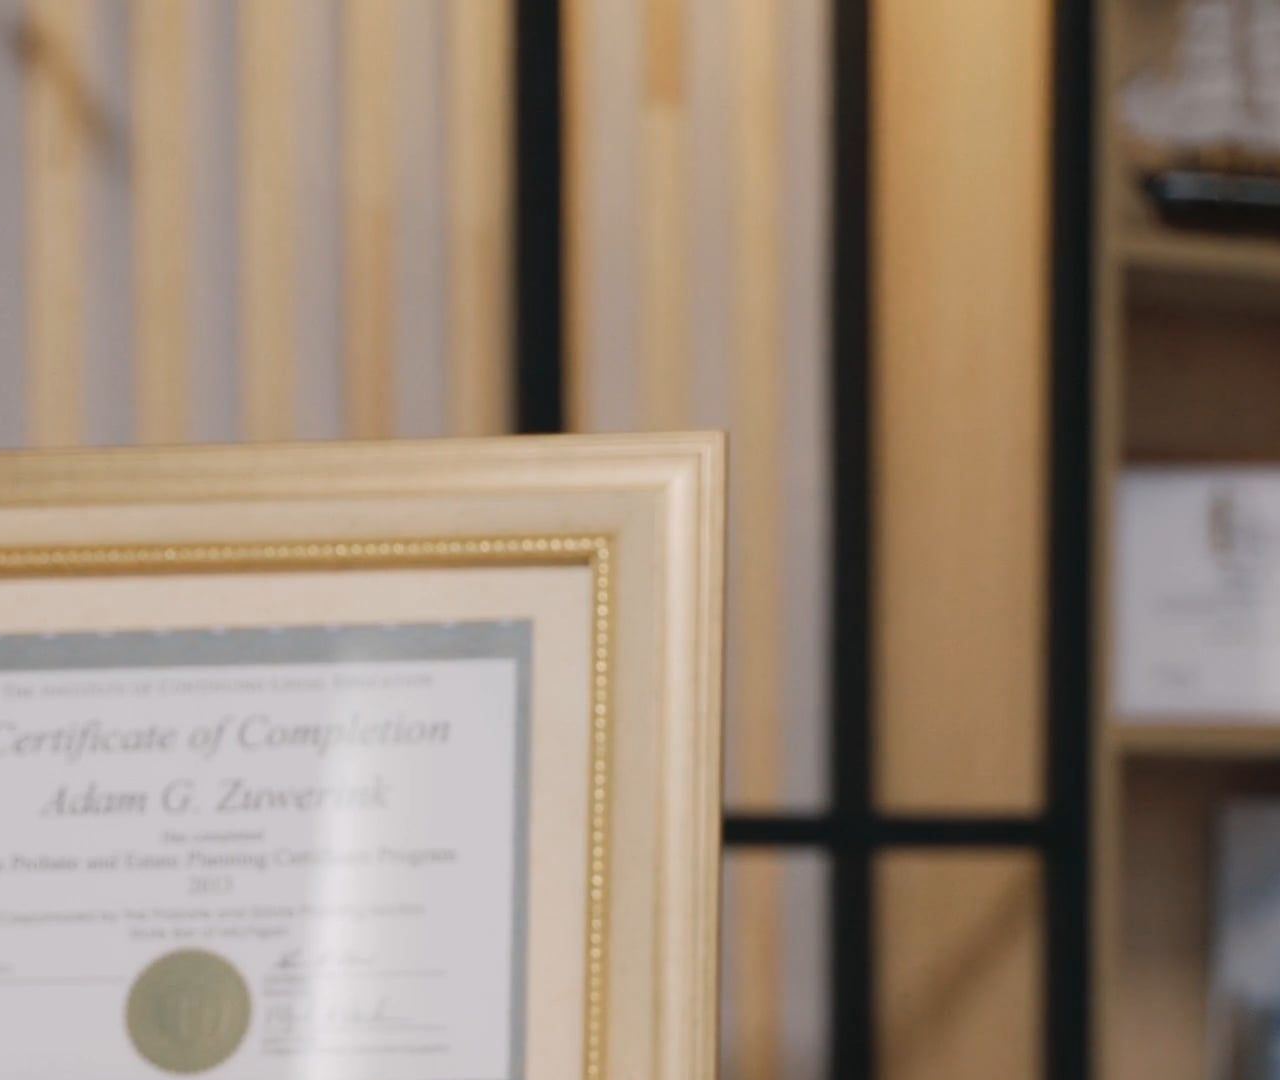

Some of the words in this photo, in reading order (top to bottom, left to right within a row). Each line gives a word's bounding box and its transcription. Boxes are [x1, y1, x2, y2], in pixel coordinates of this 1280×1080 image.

[188, 714, 233, 759] of
[237, 712, 450, 756] Completion
[39, 782, 147, 816] Adam
[160, 777, 200, 815] G.
